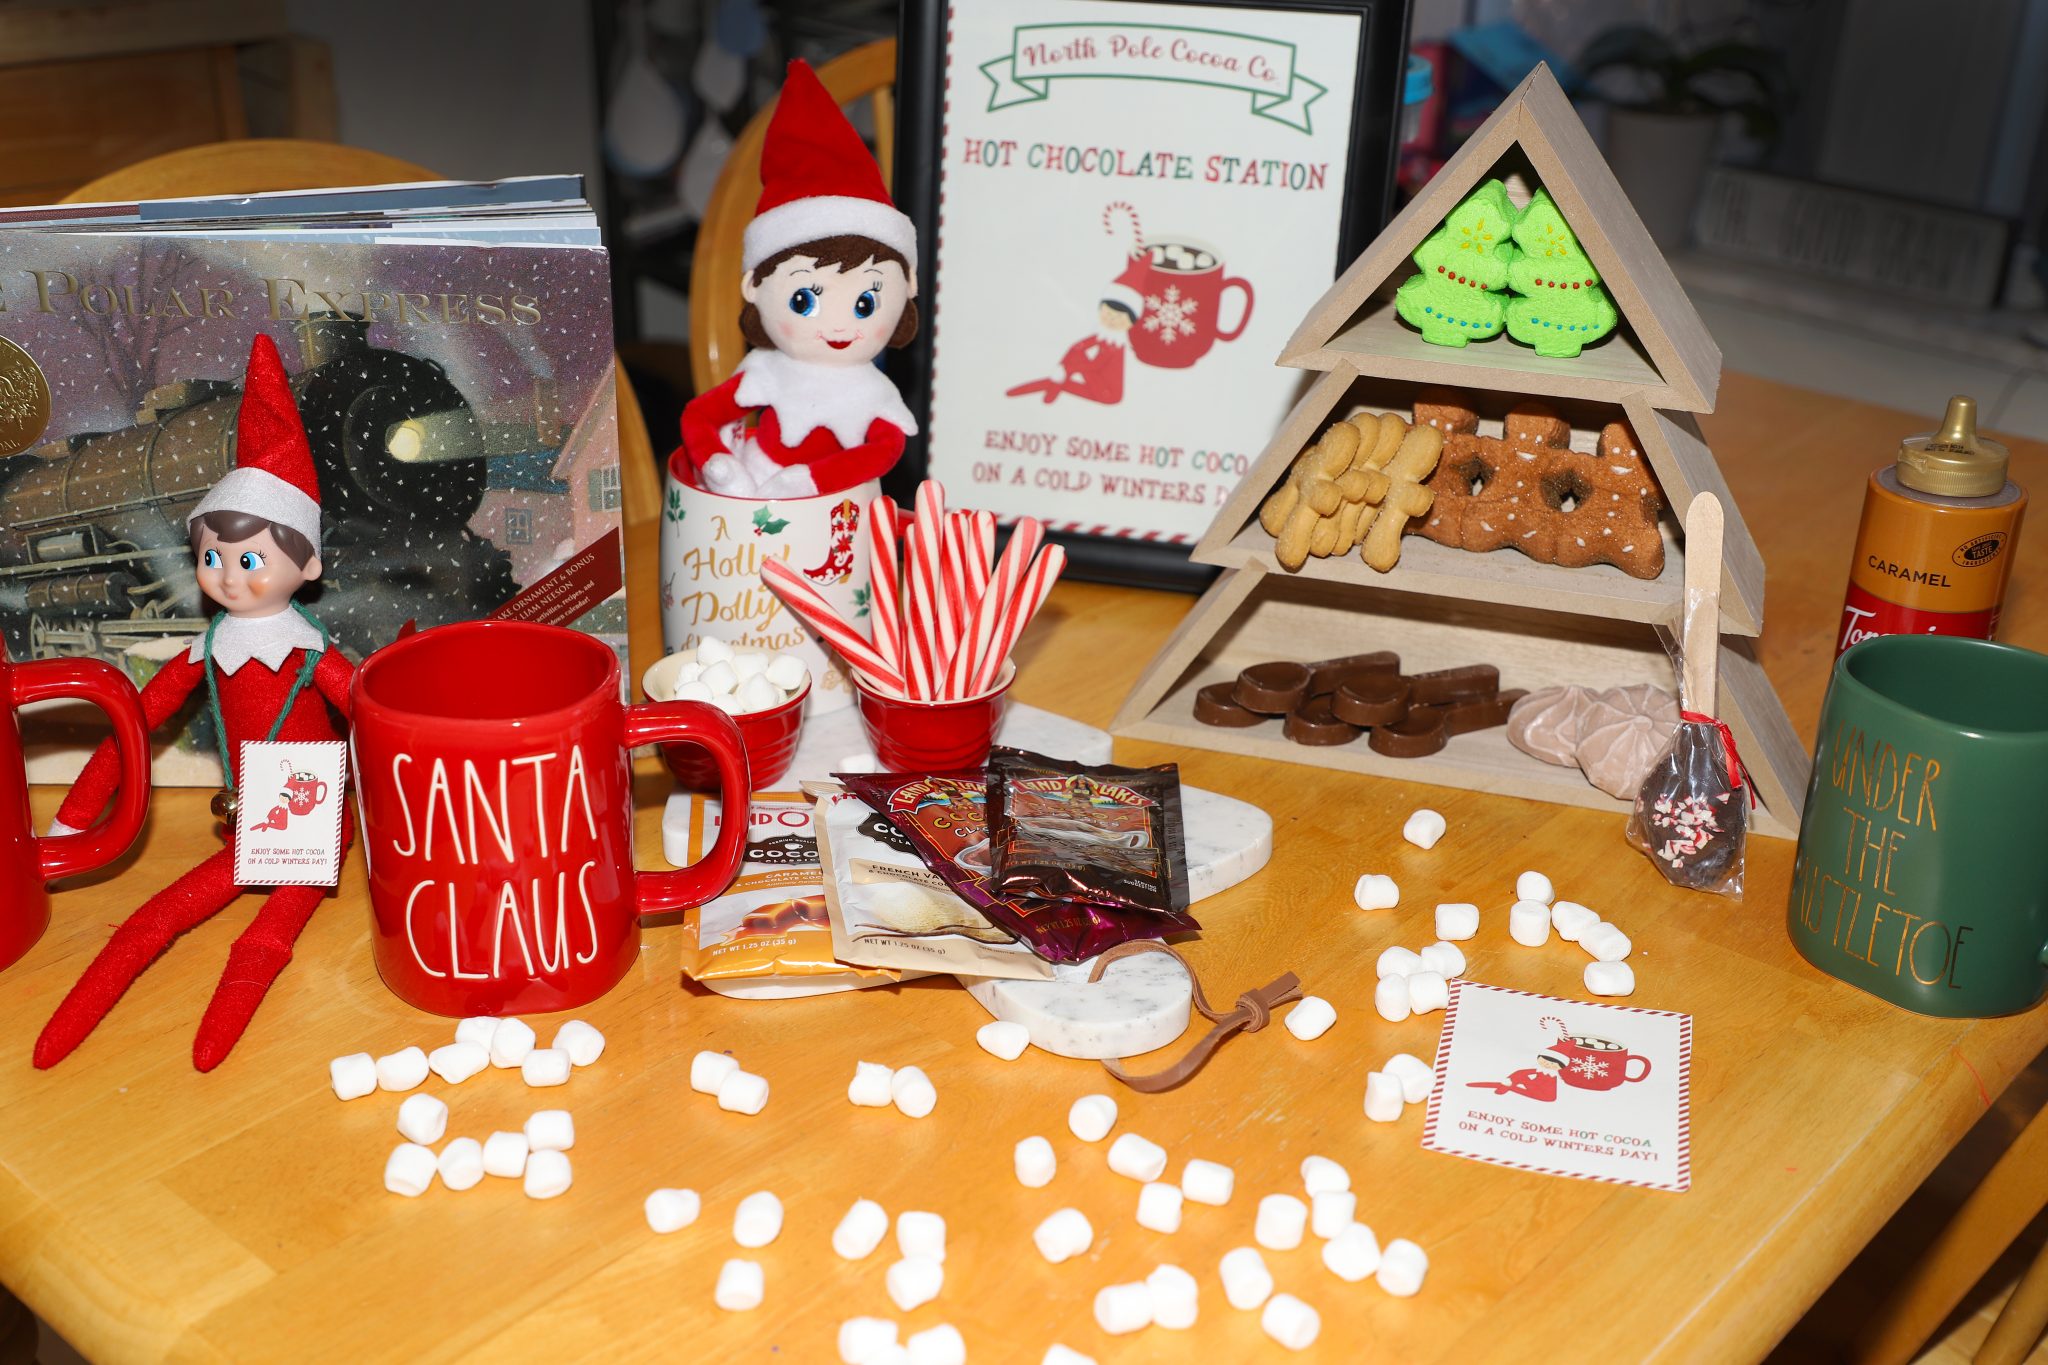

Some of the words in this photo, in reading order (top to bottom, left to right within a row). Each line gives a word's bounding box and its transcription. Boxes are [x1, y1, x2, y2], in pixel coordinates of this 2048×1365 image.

[1022, 36, 1099, 67] North
[1109, 34, 1163, 60] Pole
[1171, 37, 1240, 73] Cocoa
[962, 138, 1018, 168] HOT
[1027, 142, 1194, 181] CHOCOLATE
[1204, 154, 1328, 192] STATION
[26, 269, 242, 319] POLAR
[259, 277, 543, 327] EXPRESS
[983, 429, 1059, 457] ENJOY
[1066, 435, 1131, 463] SOME
[1138, 444, 1185, 469] HOT
[1191, 449, 1249, 477] COCO
[972, 461, 1002, 483] ON
[1011, 465, 1027, 486] A
[1034, 467, 1093, 493] COLD
[1100, 473, 1207, 505] WINTERS
[710, 515, 732, 542] A
[1867, 555, 1951, 588] CARAMEL
[1972, 545, 1993, 559] TASTE
[512, 576, 559, 611] ORNAMENT
[565, 552, 595, 577] BONUS
[519, 603, 541, 620] LIAM
[540, 580, 574, 606] NEESON
[681, 588, 784, 633] Dolly
[894, 782, 931, 805] LAND
[1020, 778, 1064, 793] LAND
[1100, 784, 1144, 807] LAKES
[1831, 719, 1941, 832] UNDER
[392, 744, 598, 865] SANTA
[250, 848, 271, 856] ENJOY
[272, 848, 291, 856] SOME
[291, 848, 304, 856] HOT
[305, 848, 325, 856] COCOA
[264, 858, 280, 866] COLD
[281, 858, 310, 866] WINTERS
[748, 848, 820, 859] COCO
[1842, 805, 1906, 897] THE
[871, 864, 920, 878] FRENCH
[405, 860, 599, 979] CLAUS
[712, 948, 727, 956] NET
[743, 942, 758, 950] 1.25
[772, 938, 786, 947] (35
[787, 938, 797, 946] g)
[1458, 1120, 1478, 1132] ON
[1484, 1126, 1495, 1136] A
[1499, 1129, 1538, 1144] COLD
[1543, 1137, 1615, 1157] WINTERS
[1619, 1148, 1660, 1163] DAY!
[1467, 1109, 1516, 1128] ENJOY
[1520, 1120, 1563, 1136] SOME
[1568, 1128, 1599, 1141] HOT
[1603, 1133, 1653, 1148] COCOA
